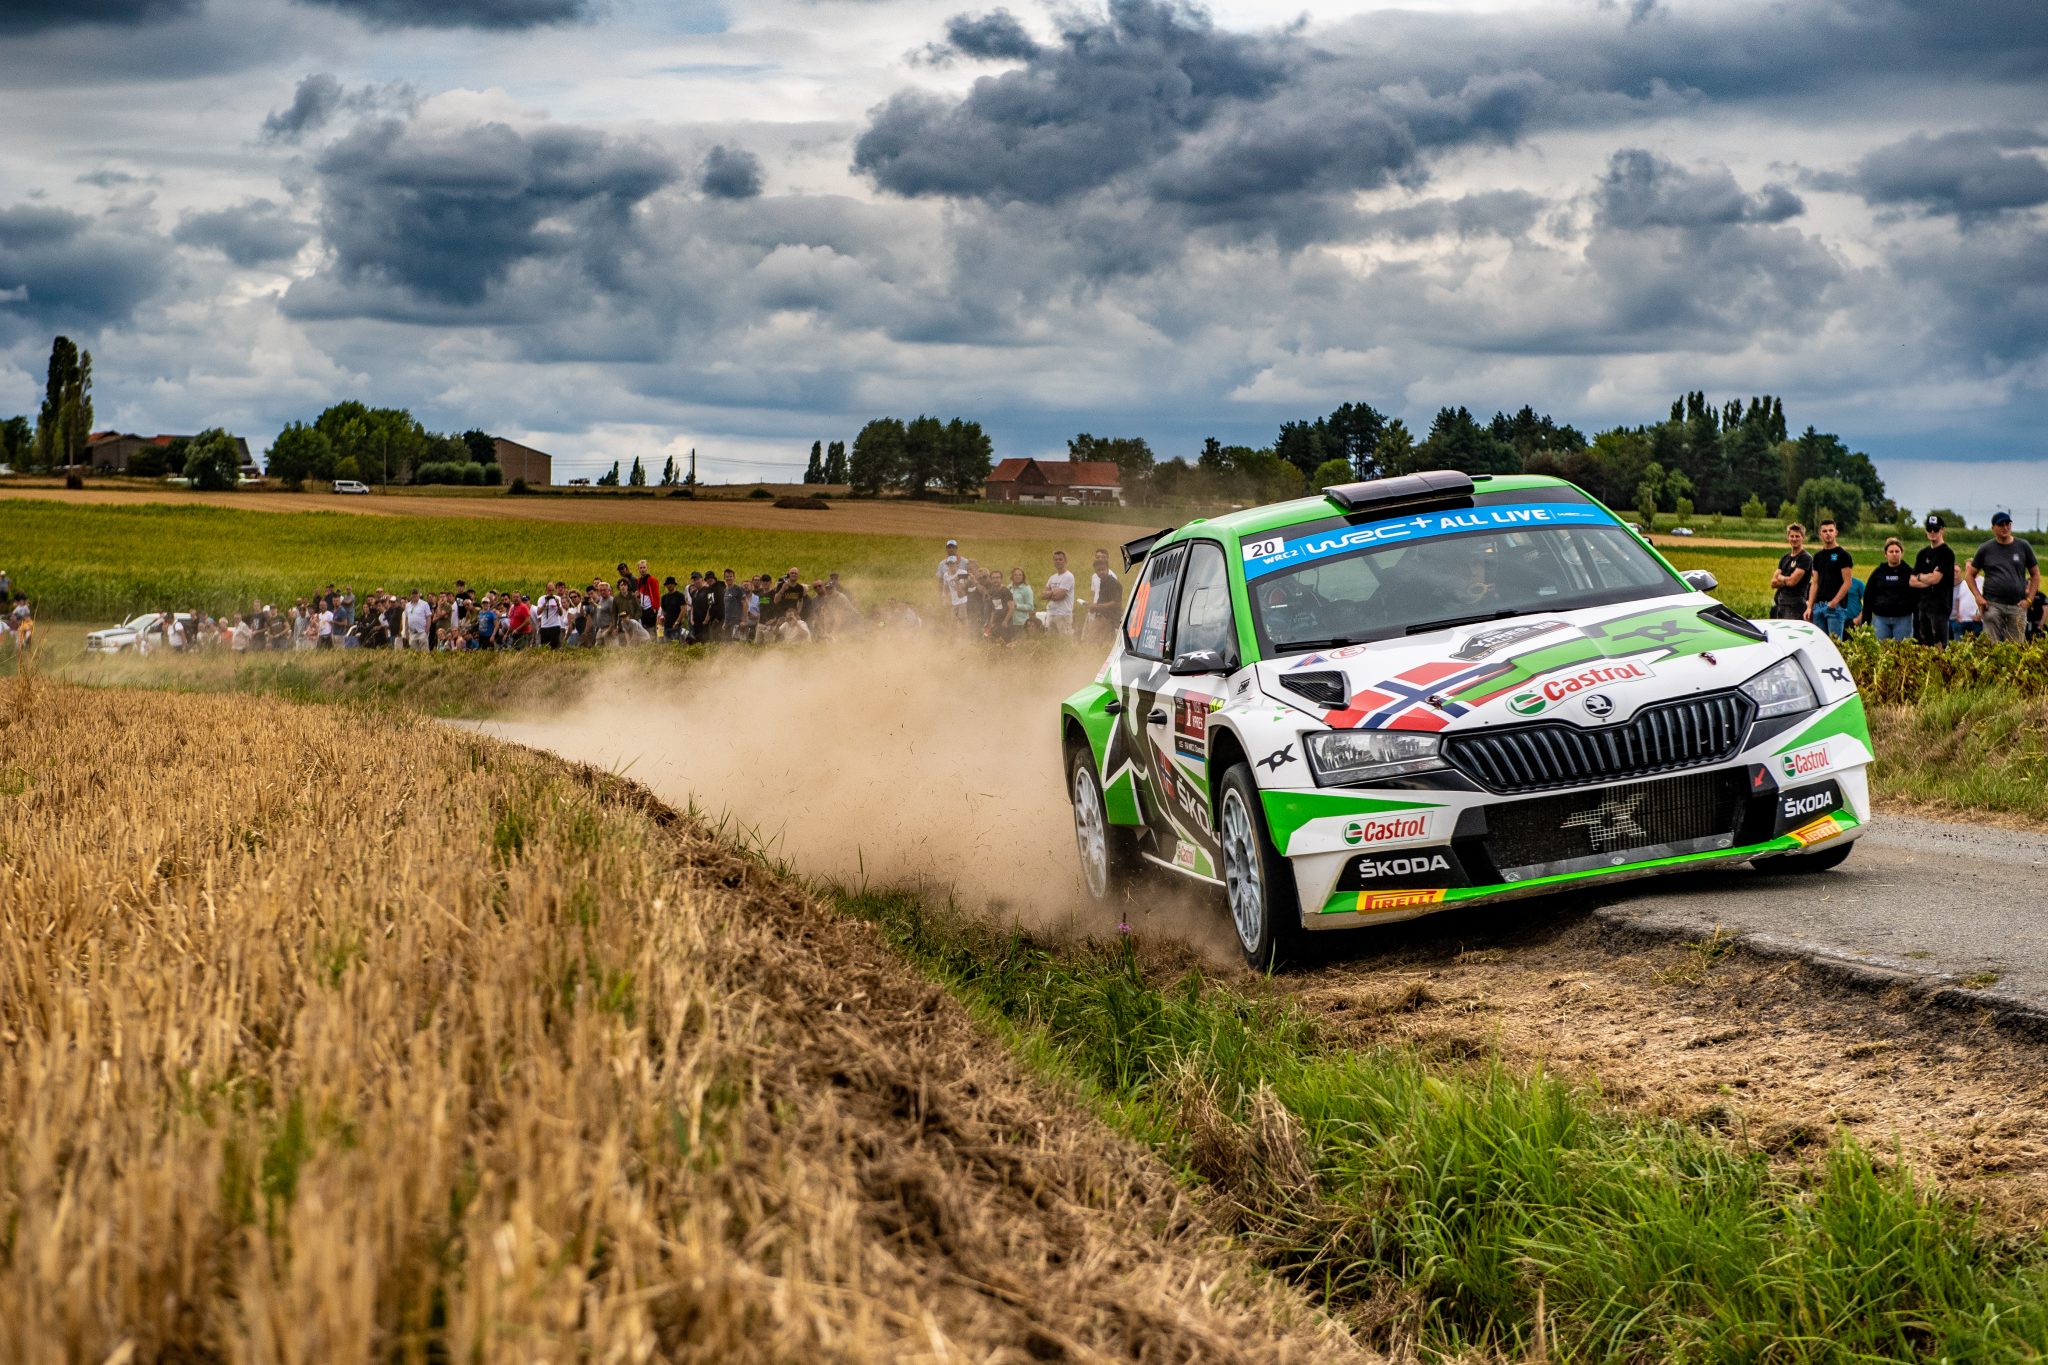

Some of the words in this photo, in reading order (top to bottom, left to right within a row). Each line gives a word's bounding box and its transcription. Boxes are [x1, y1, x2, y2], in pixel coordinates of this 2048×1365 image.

[1441, 512, 1488, 529] ALL
[1491, 509, 1550, 523] LIVE
[1251, 541, 1275, 558] 20
[1262, 549, 1299, 565] WRC2
[1543, 663, 1646, 702] Castrol
[1795, 747, 1830, 774] Castrol
[1784, 790, 1833, 818] ŠKODA
[1364, 815, 1426, 842] Castrol
[1359, 854, 1450, 878] ŠKODA
[1365, 890, 1437, 910] PIRELLI
